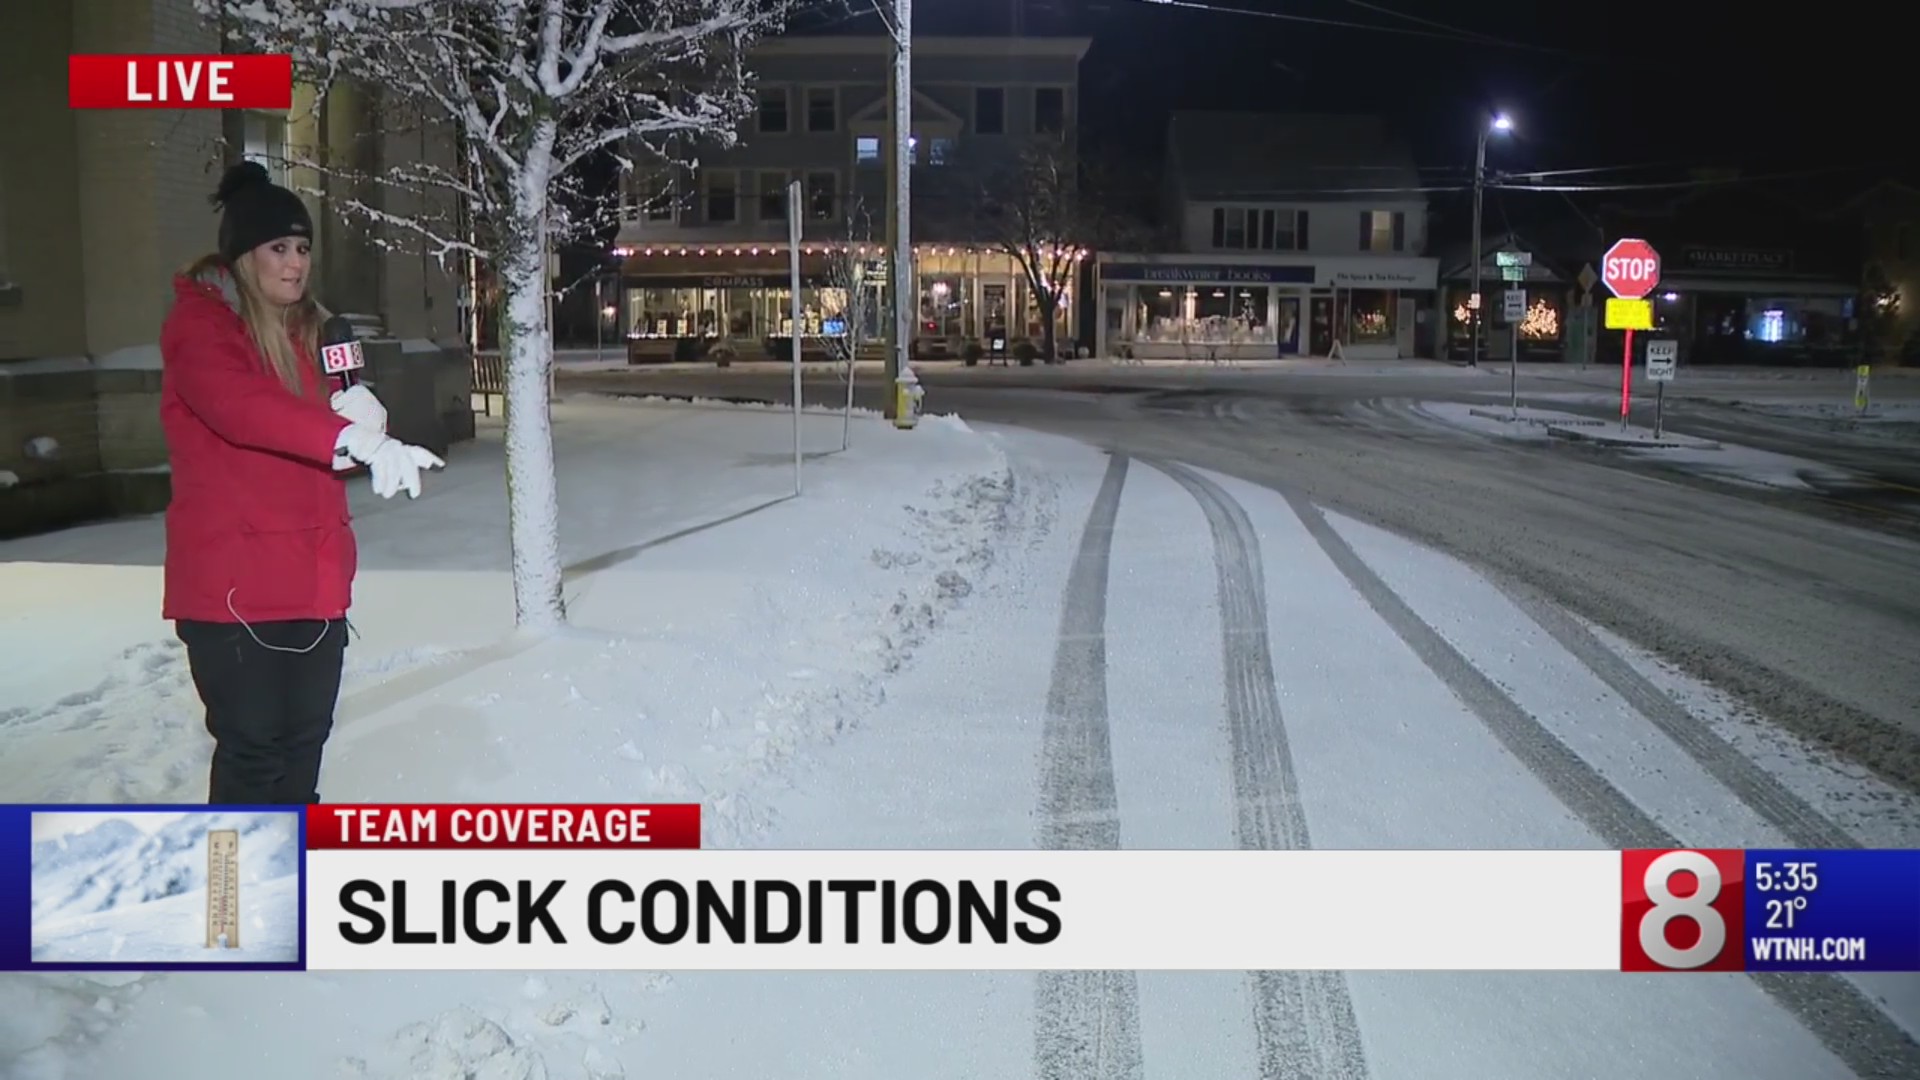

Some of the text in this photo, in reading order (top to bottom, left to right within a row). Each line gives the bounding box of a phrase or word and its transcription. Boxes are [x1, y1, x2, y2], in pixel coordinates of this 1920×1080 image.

[1143, 268, 1271, 281] breakwater books
[1607, 258, 1656, 280] STOP
[703, 276, 764, 287] COMPASS
[352, 343, 363, 366] 8
[1650, 346, 1673, 355] KEEP
[329, 348, 345, 369] 8
[1649, 367, 1673, 376] RIGHT
